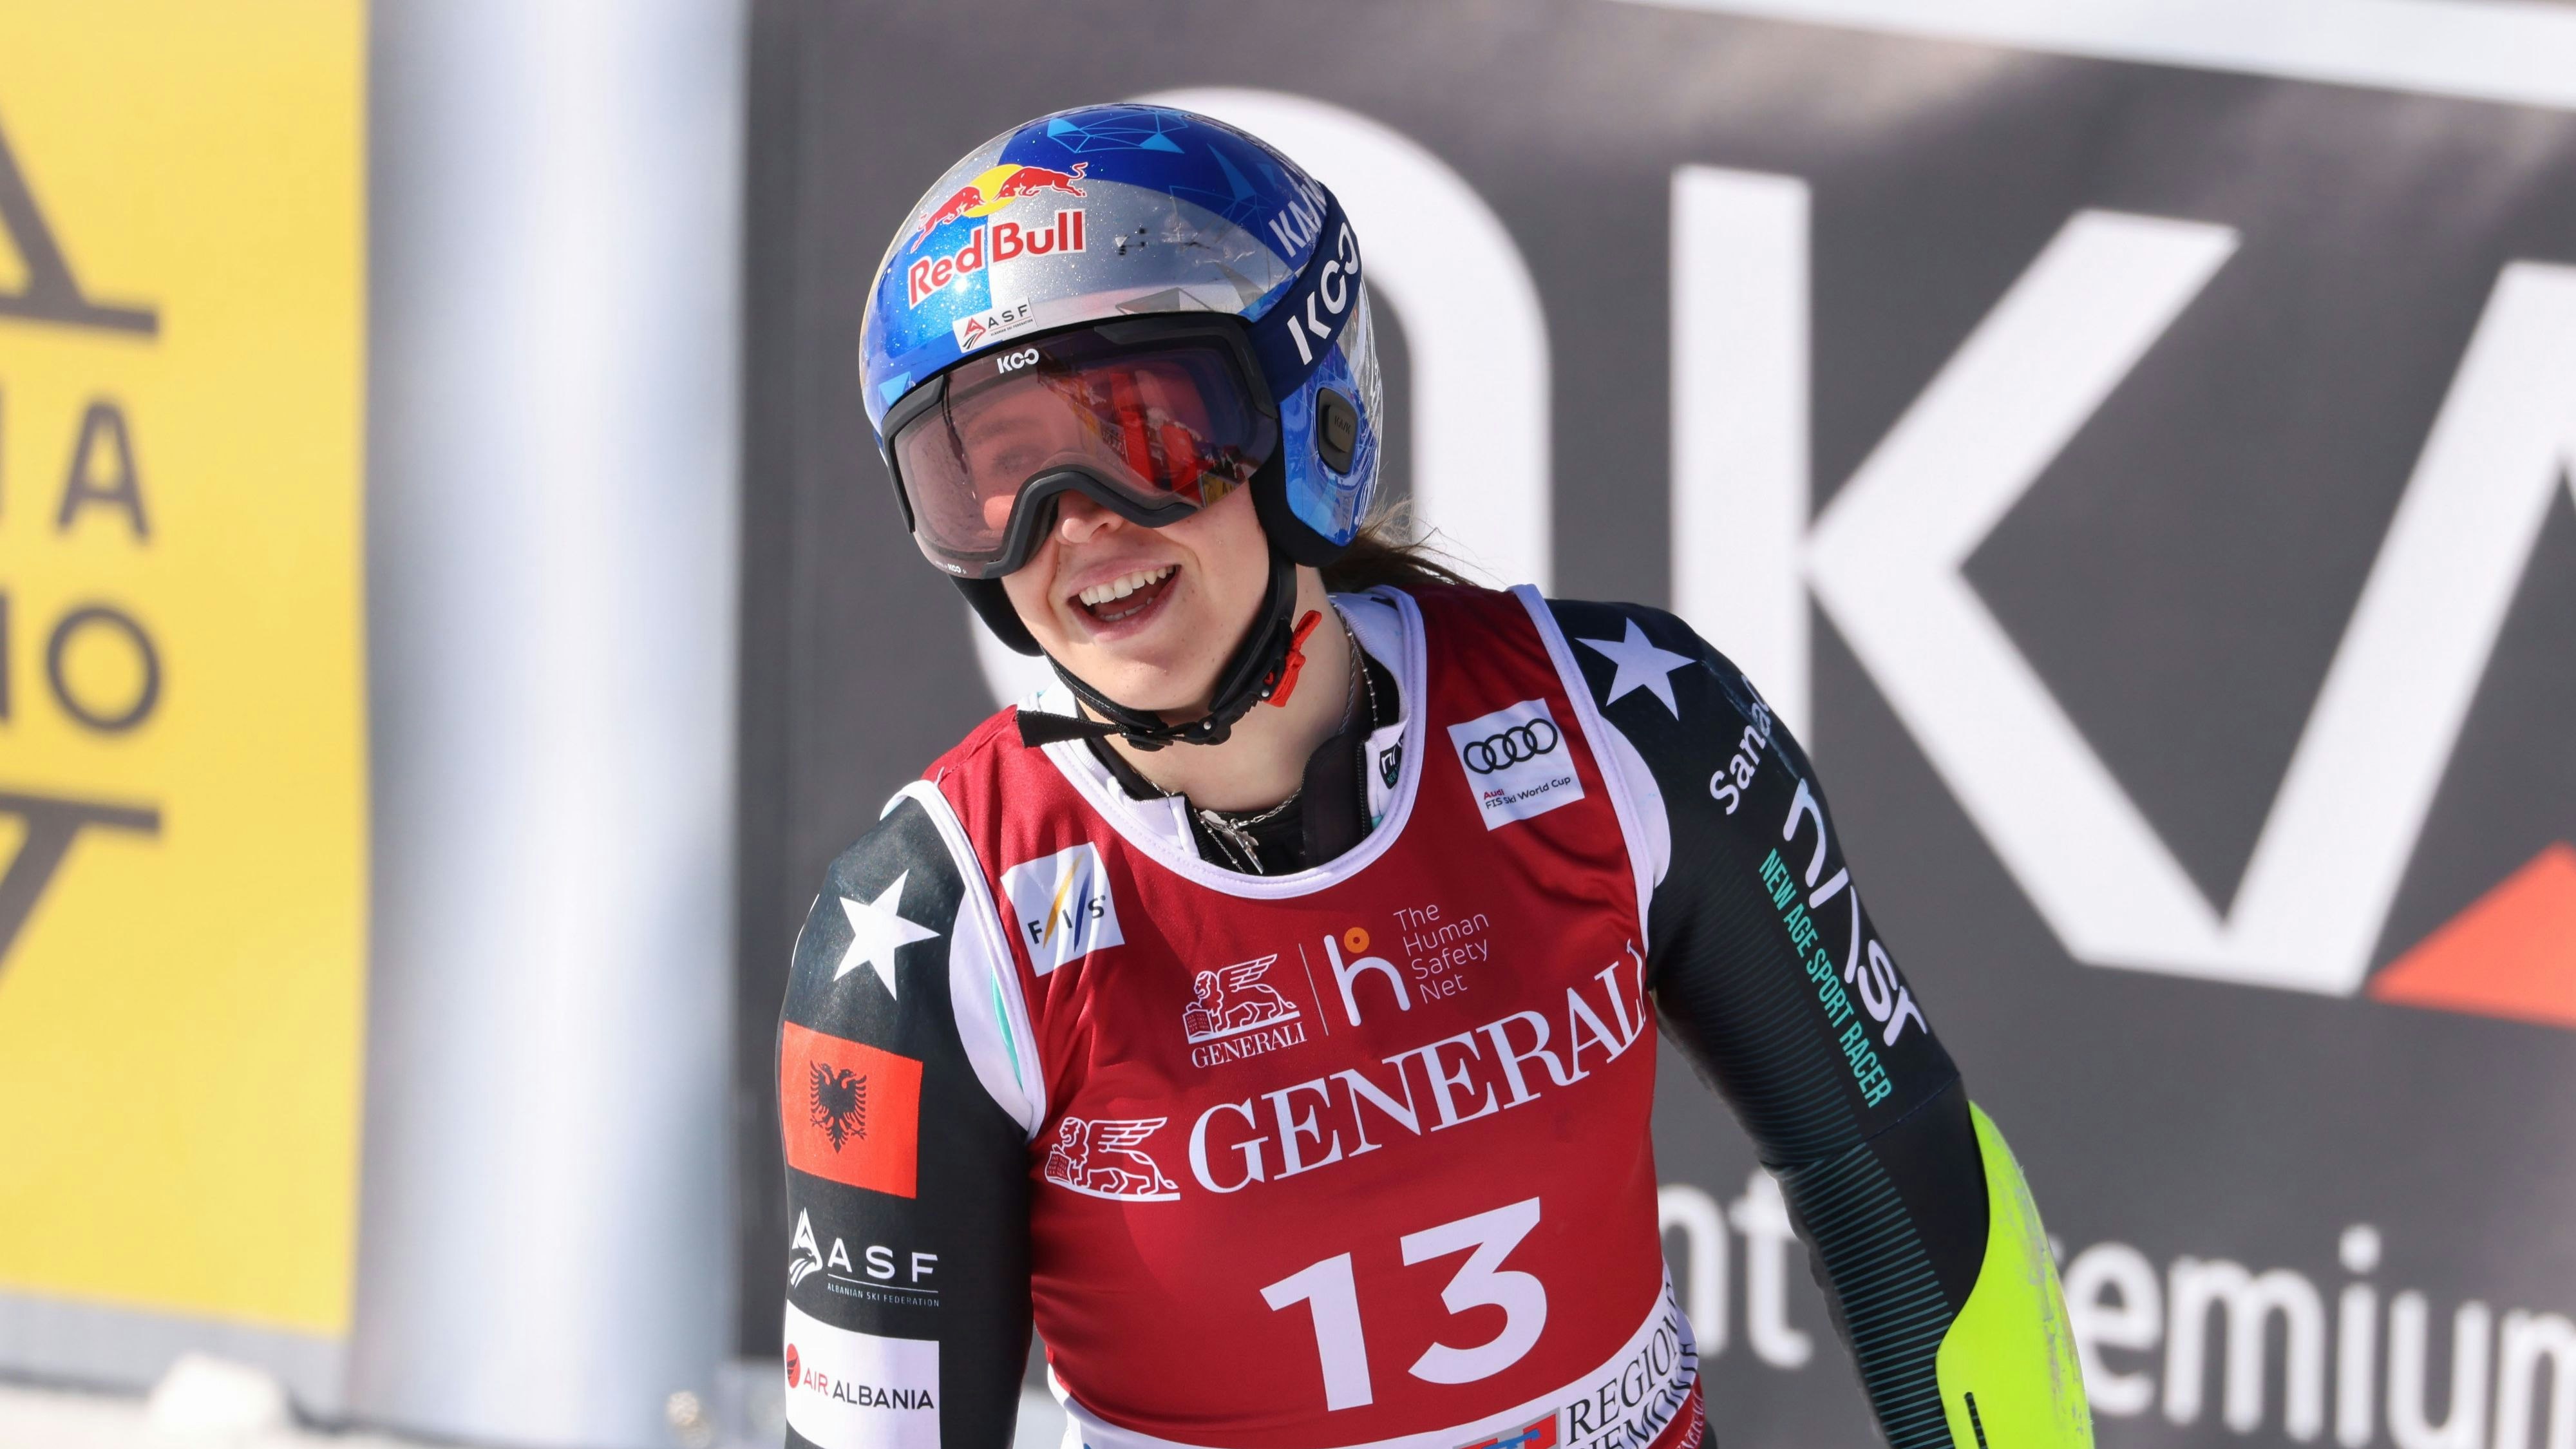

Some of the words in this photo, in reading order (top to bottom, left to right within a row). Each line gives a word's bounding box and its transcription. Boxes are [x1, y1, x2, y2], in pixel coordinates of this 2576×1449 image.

[909, 228, 983, 307] Red
[992, 211, 1084, 263] Bull
[988, 304, 1028, 329] ASF
[1484, 788, 1505, 800] Audi
[1485, 797, 1503, 810] FIS
[1503, 795, 1517, 804] Ski
[1517, 783, 1549, 800] World
[1551, 777, 1571, 788] Cup
[1028, 896, 1106, 944] FIS
[1393, 904, 1440, 931] The
[1403, 914, 1489, 956] Human
[1411, 938, 1487, 980] Safety
[1759, 848, 1797, 911] NEW
[1783, 903, 1819, 958] AGE
[1806, 948, 1855, 1028] SPORT
[1839, 1021, 1892, 1108] RACER
[1419, 974, 1468, 1004] Net
[1191, 1021, 1307, 1069] GENERALI
[827, 1237, 938, 1283] ASF
[827, 1282, 864, 1298] ALBANIAN
[866, 1291, 880, 1302] SKI
[883, 1294, 940, 1308] FEDERATION
[1260, 1196, 1548, 1412] 13
[803, 1367, 829, 1396] AIR
[832, 1379, 934, 1410] ALBANIA
